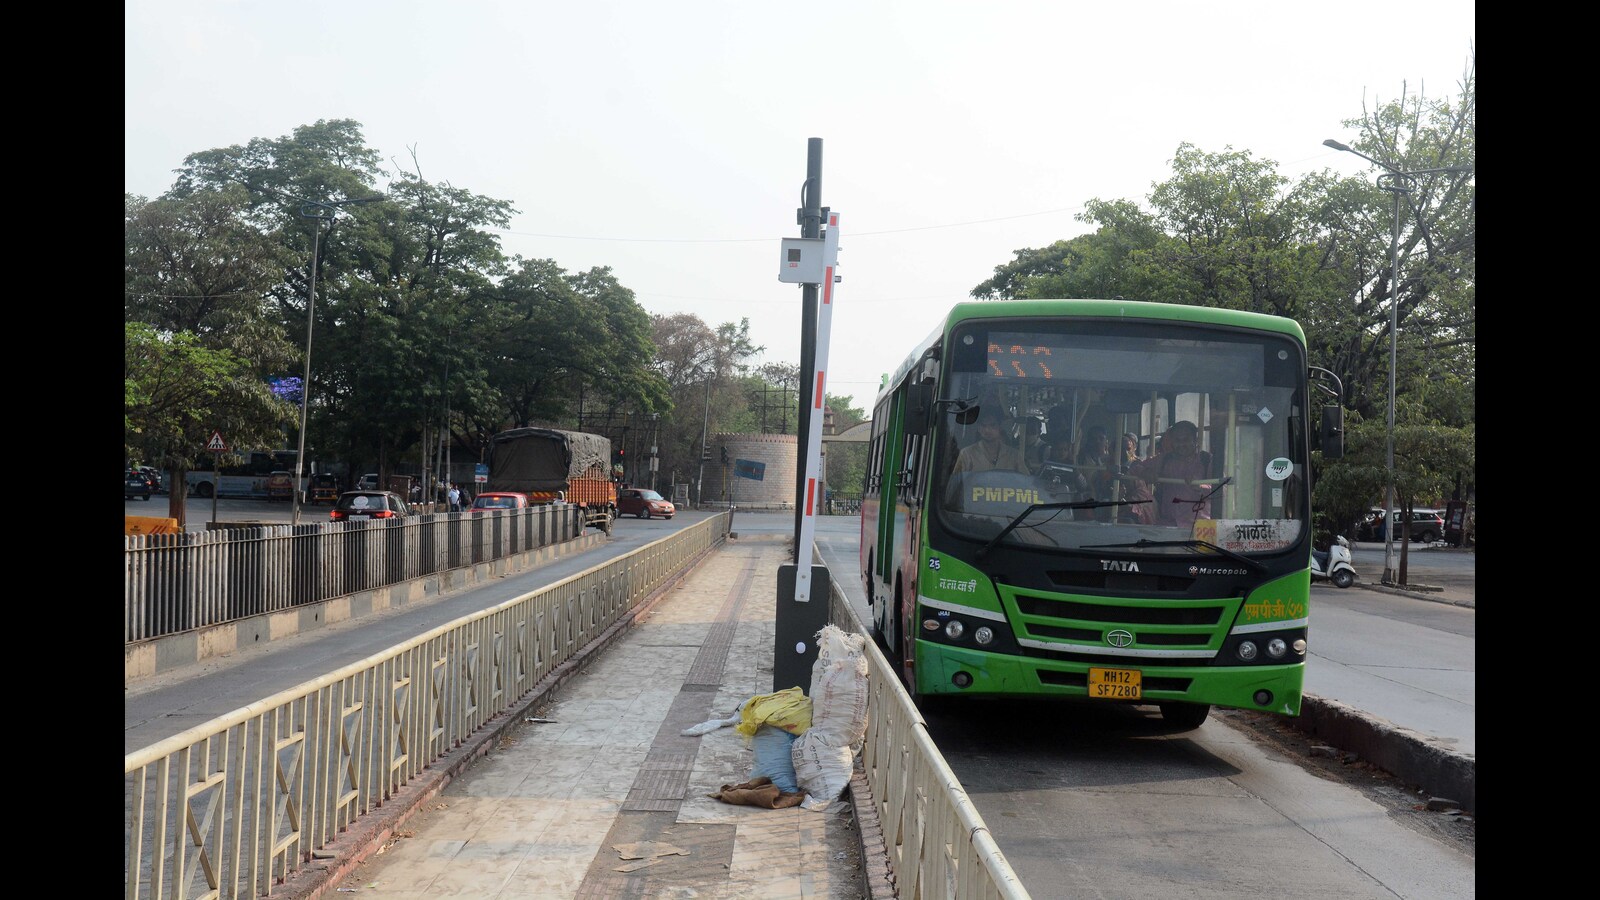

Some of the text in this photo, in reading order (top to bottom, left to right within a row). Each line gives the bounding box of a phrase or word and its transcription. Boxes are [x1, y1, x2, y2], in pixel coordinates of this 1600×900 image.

[972, 487, 1044, 505] PMPML
[929, 558, 941, 570] 25
[1101, 560, 1140, 572] TATA
[1200, 567, 1248, 576] Marcopolo
[1103, 671, 1131, 684] MH12
[1097, 684, 1137, 697] SF7280
